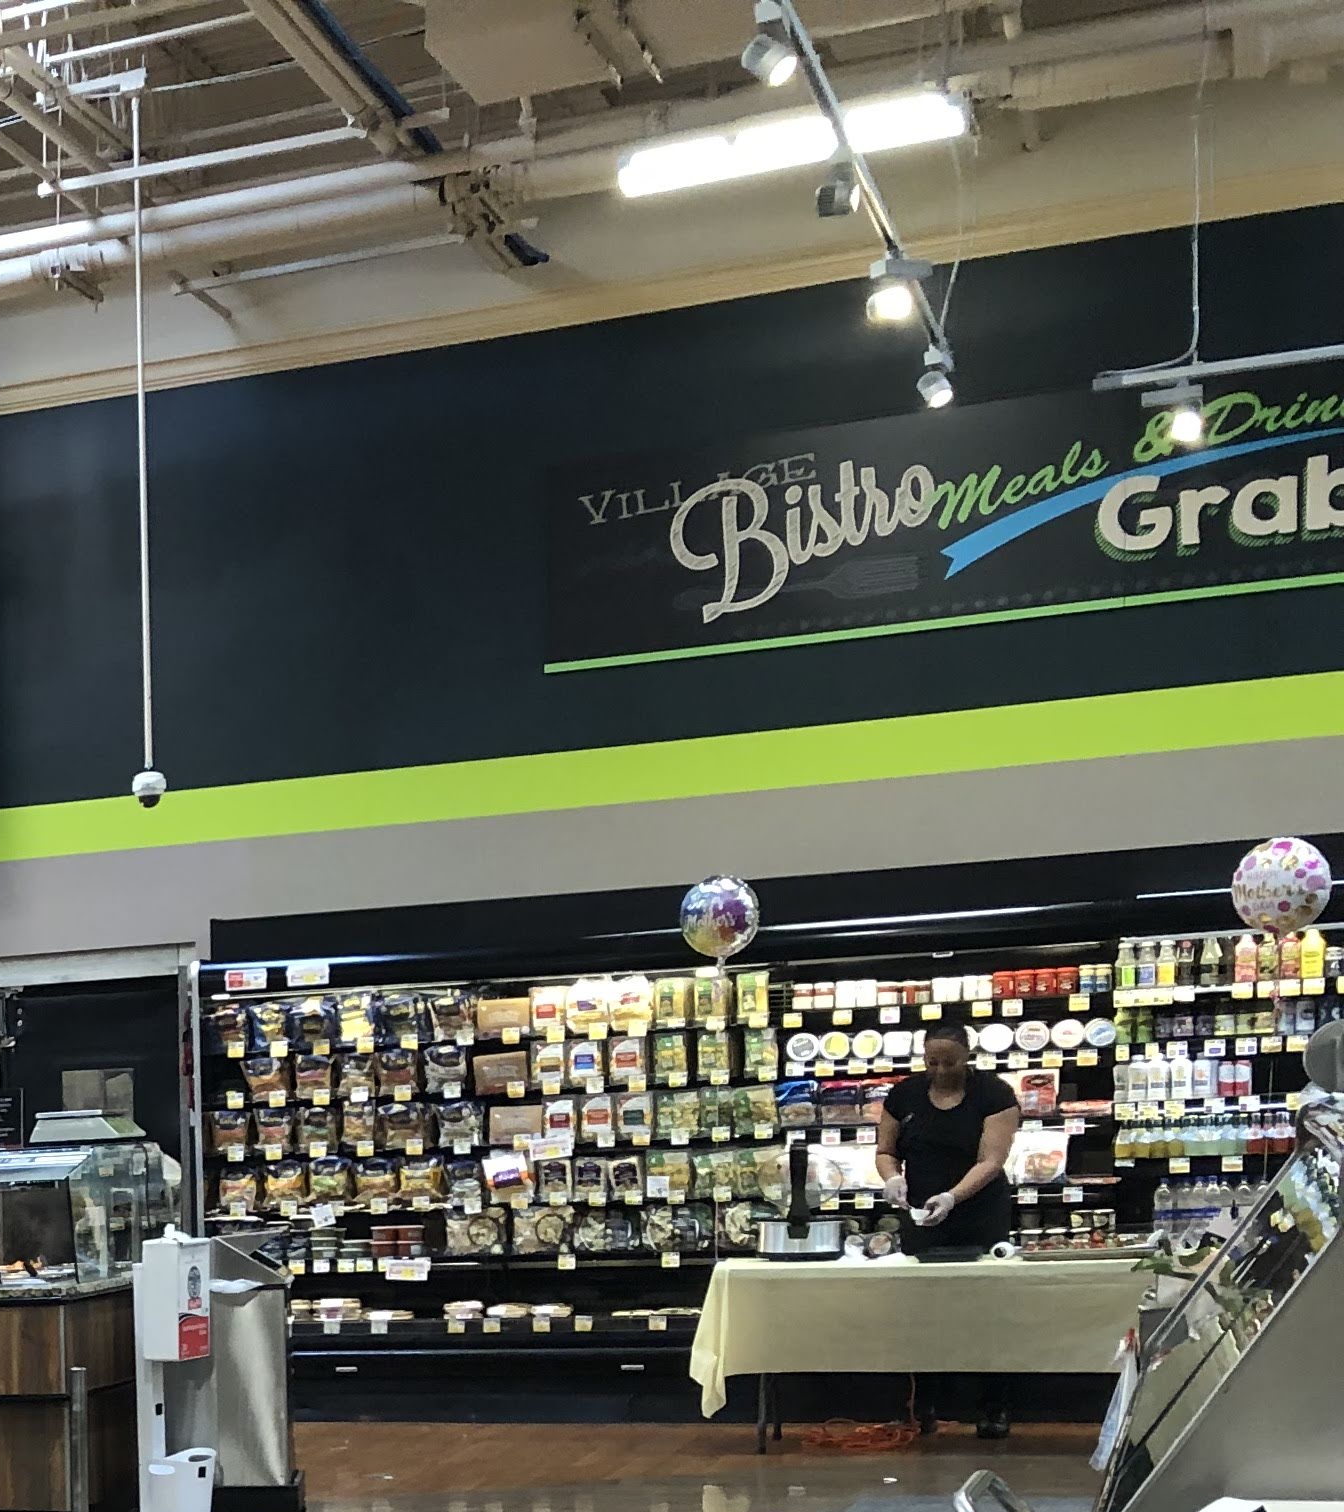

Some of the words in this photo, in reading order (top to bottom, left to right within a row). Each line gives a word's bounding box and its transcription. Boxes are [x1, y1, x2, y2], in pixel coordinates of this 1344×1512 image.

[578, 452, 816, 525] VILLGE
[932, 441, 1109, 531] Meals
[1133, 409, 1178, 463] &
[1096, 454, 1344, 558] Grab
[669, 458, 938, 624] Bistro
